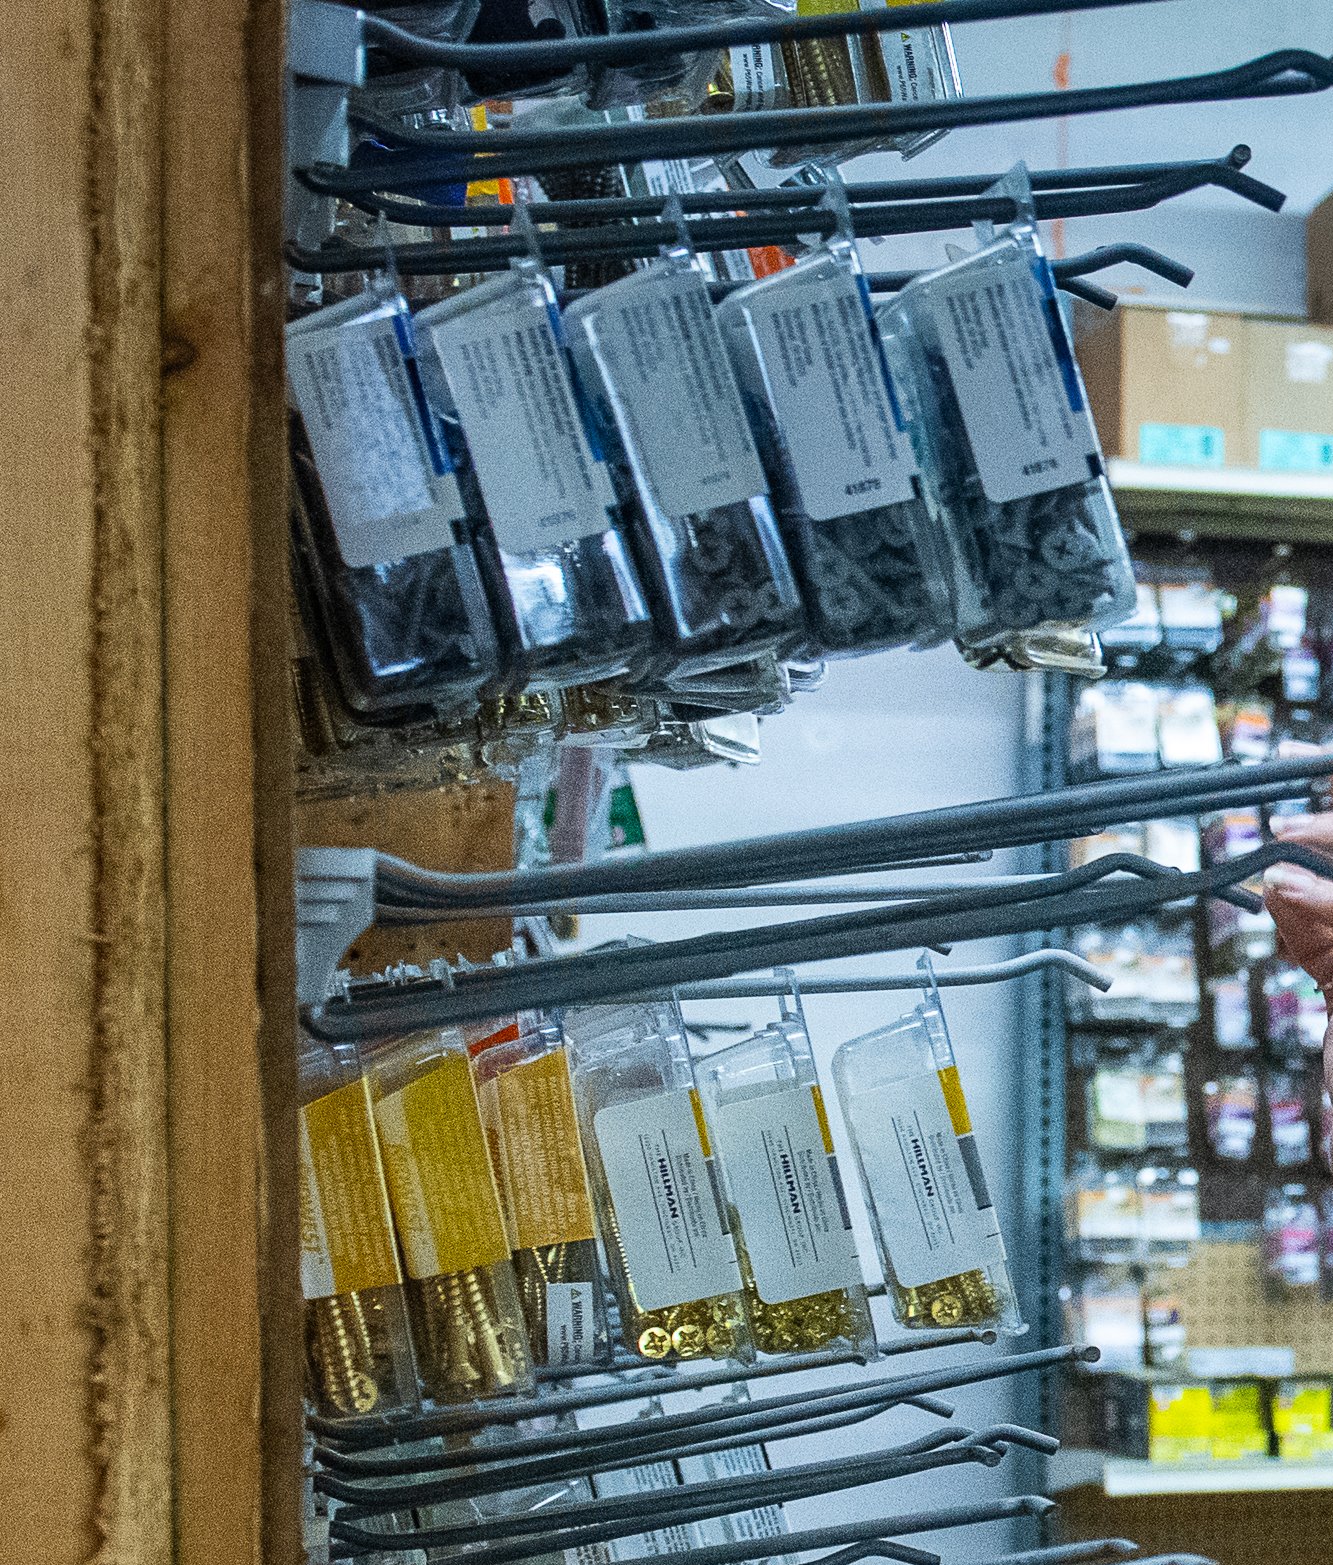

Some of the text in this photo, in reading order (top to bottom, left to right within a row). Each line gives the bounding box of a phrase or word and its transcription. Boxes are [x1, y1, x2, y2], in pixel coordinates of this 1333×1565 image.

[657, 1158, 679, 1218] HILLMAN
[780, 1154, 802, 1213] HILLMAN
[910, 1138, 935, 1197] HILLMAN
